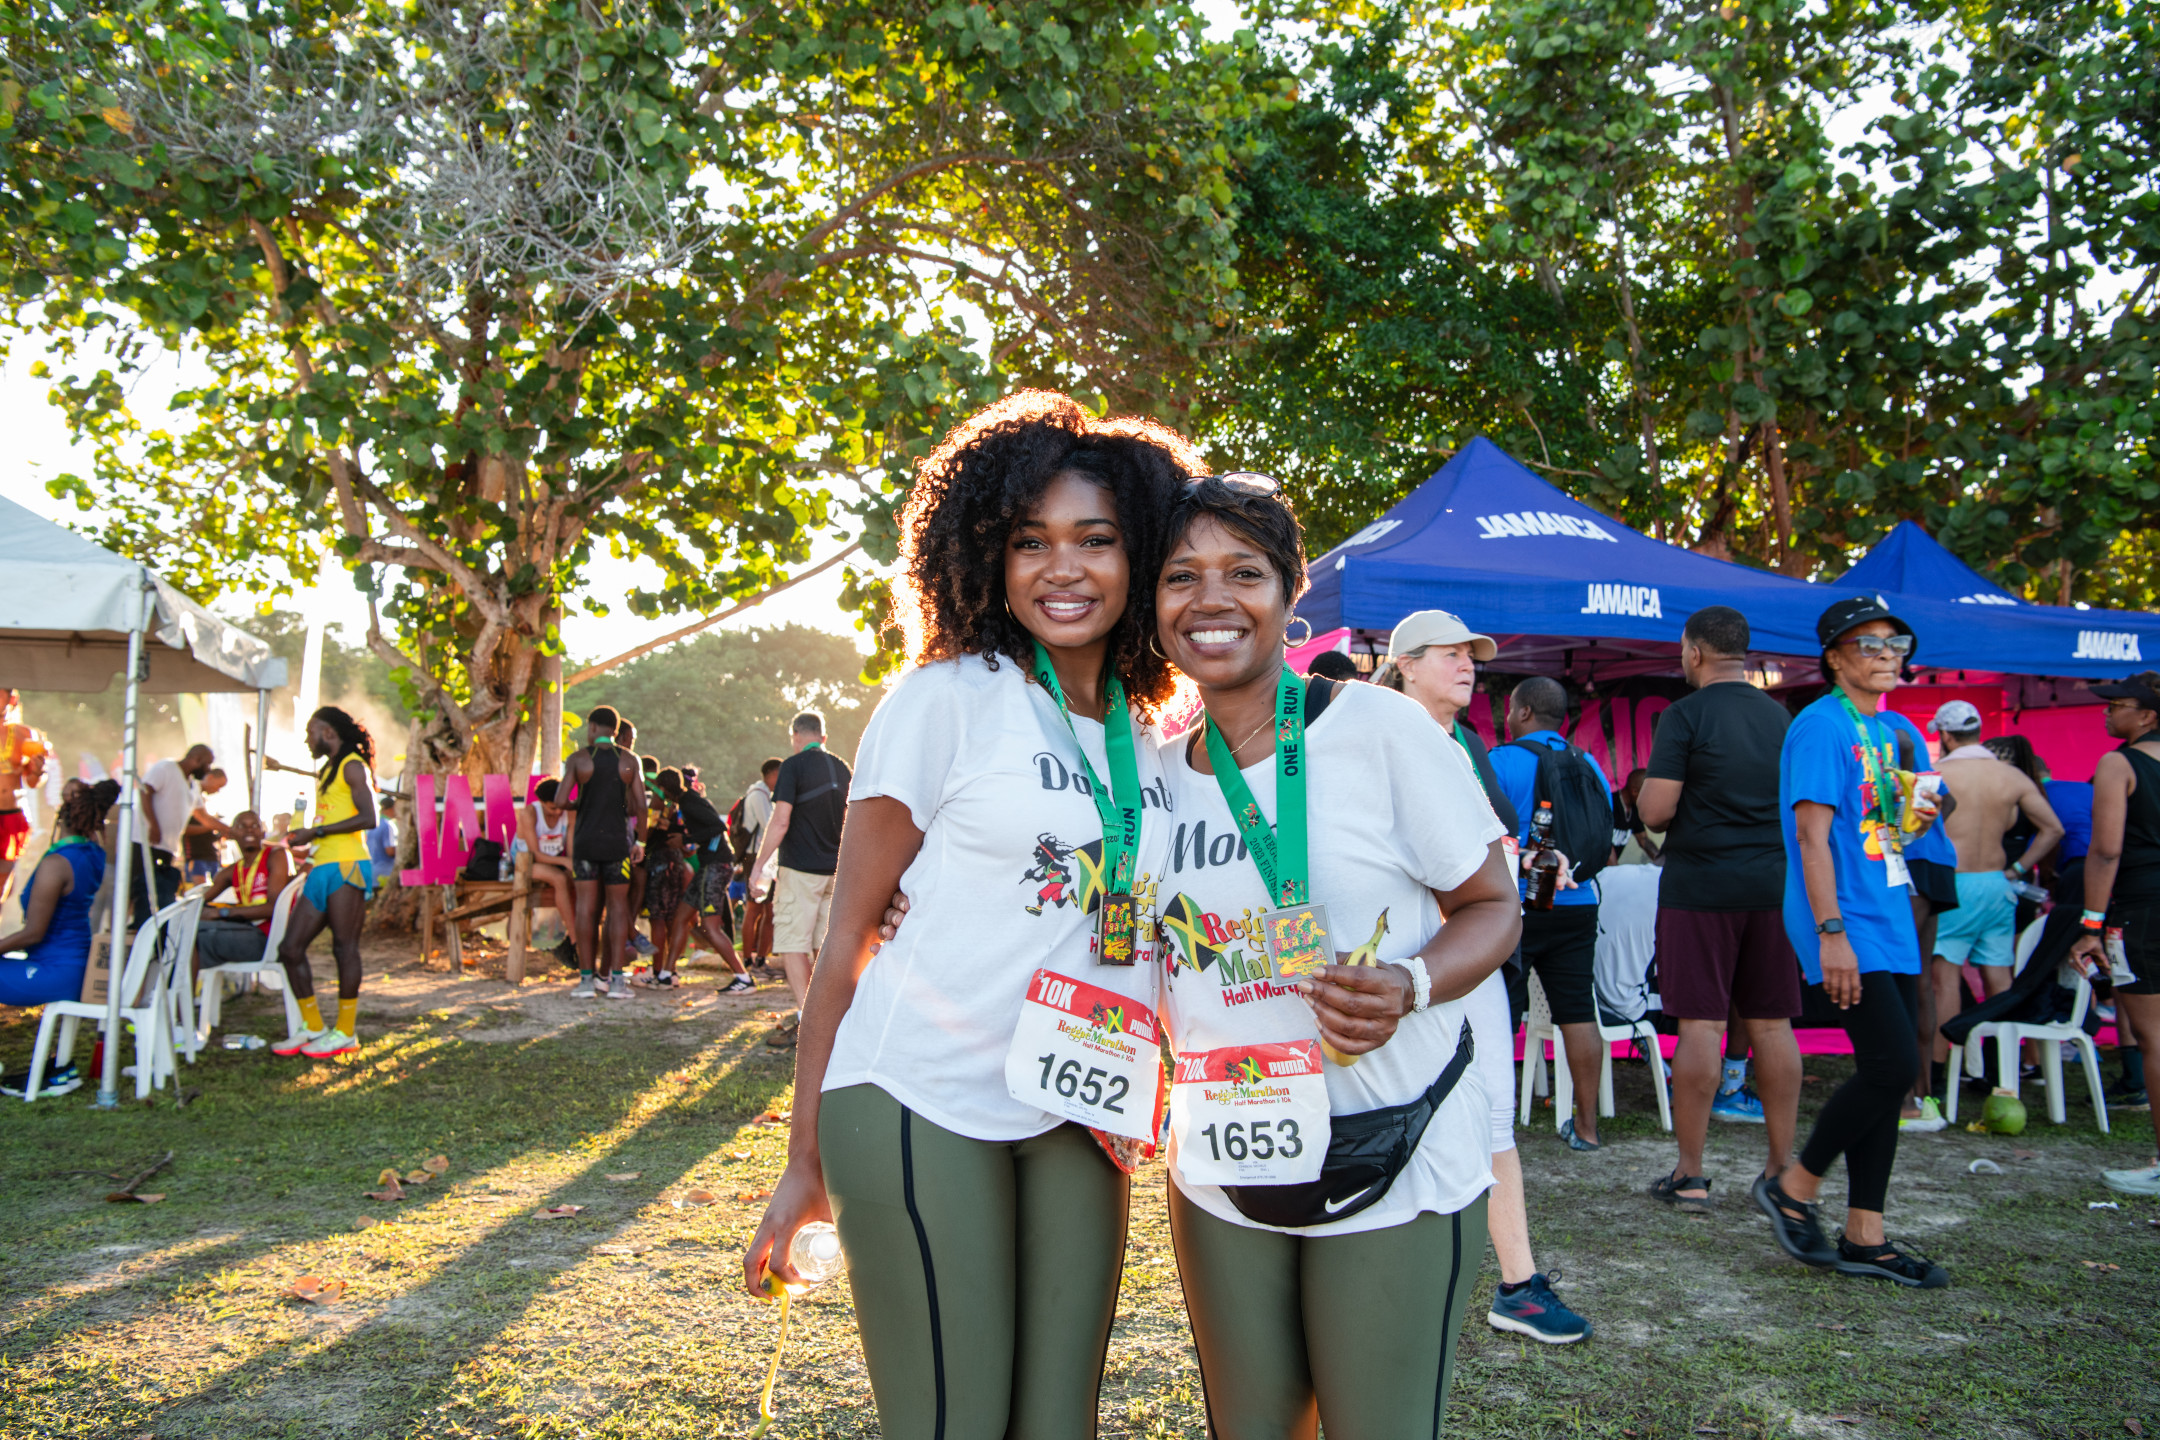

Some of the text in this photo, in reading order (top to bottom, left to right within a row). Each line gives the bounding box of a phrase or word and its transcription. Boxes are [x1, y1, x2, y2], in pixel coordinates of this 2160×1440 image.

[1476, 511, 1619, 543] JAMAICA
[1581, 583, 1662, 619] JAMAICA
[2072, 630, 2142, 662] JAMAICA
[1283, 686, 1299, 715] RUN
[1284, 743, 1299, 777] ONE
[1122, 807, 1136, 847] RUN
[1249, 837, 1265, 860] 2023
[1037, 976, 1078, 1011] 10K
[1222, 984, 1254, 1007] Half
[1082, 1040, 1094, 1050] Half
[1094, 1045, 1120, 1059] Marathon
[1038, 1052, 1129, 1115] 1652
[1181, 1055, 1208, 1081] 10K
[1268, 1059, 1307, 1076] PUMA
[1234, 1099, 1247, 1107] Half
[1247, 1098, 1276, 1106] Marathon
[1201, 1118, 1303, 1161] 1653
